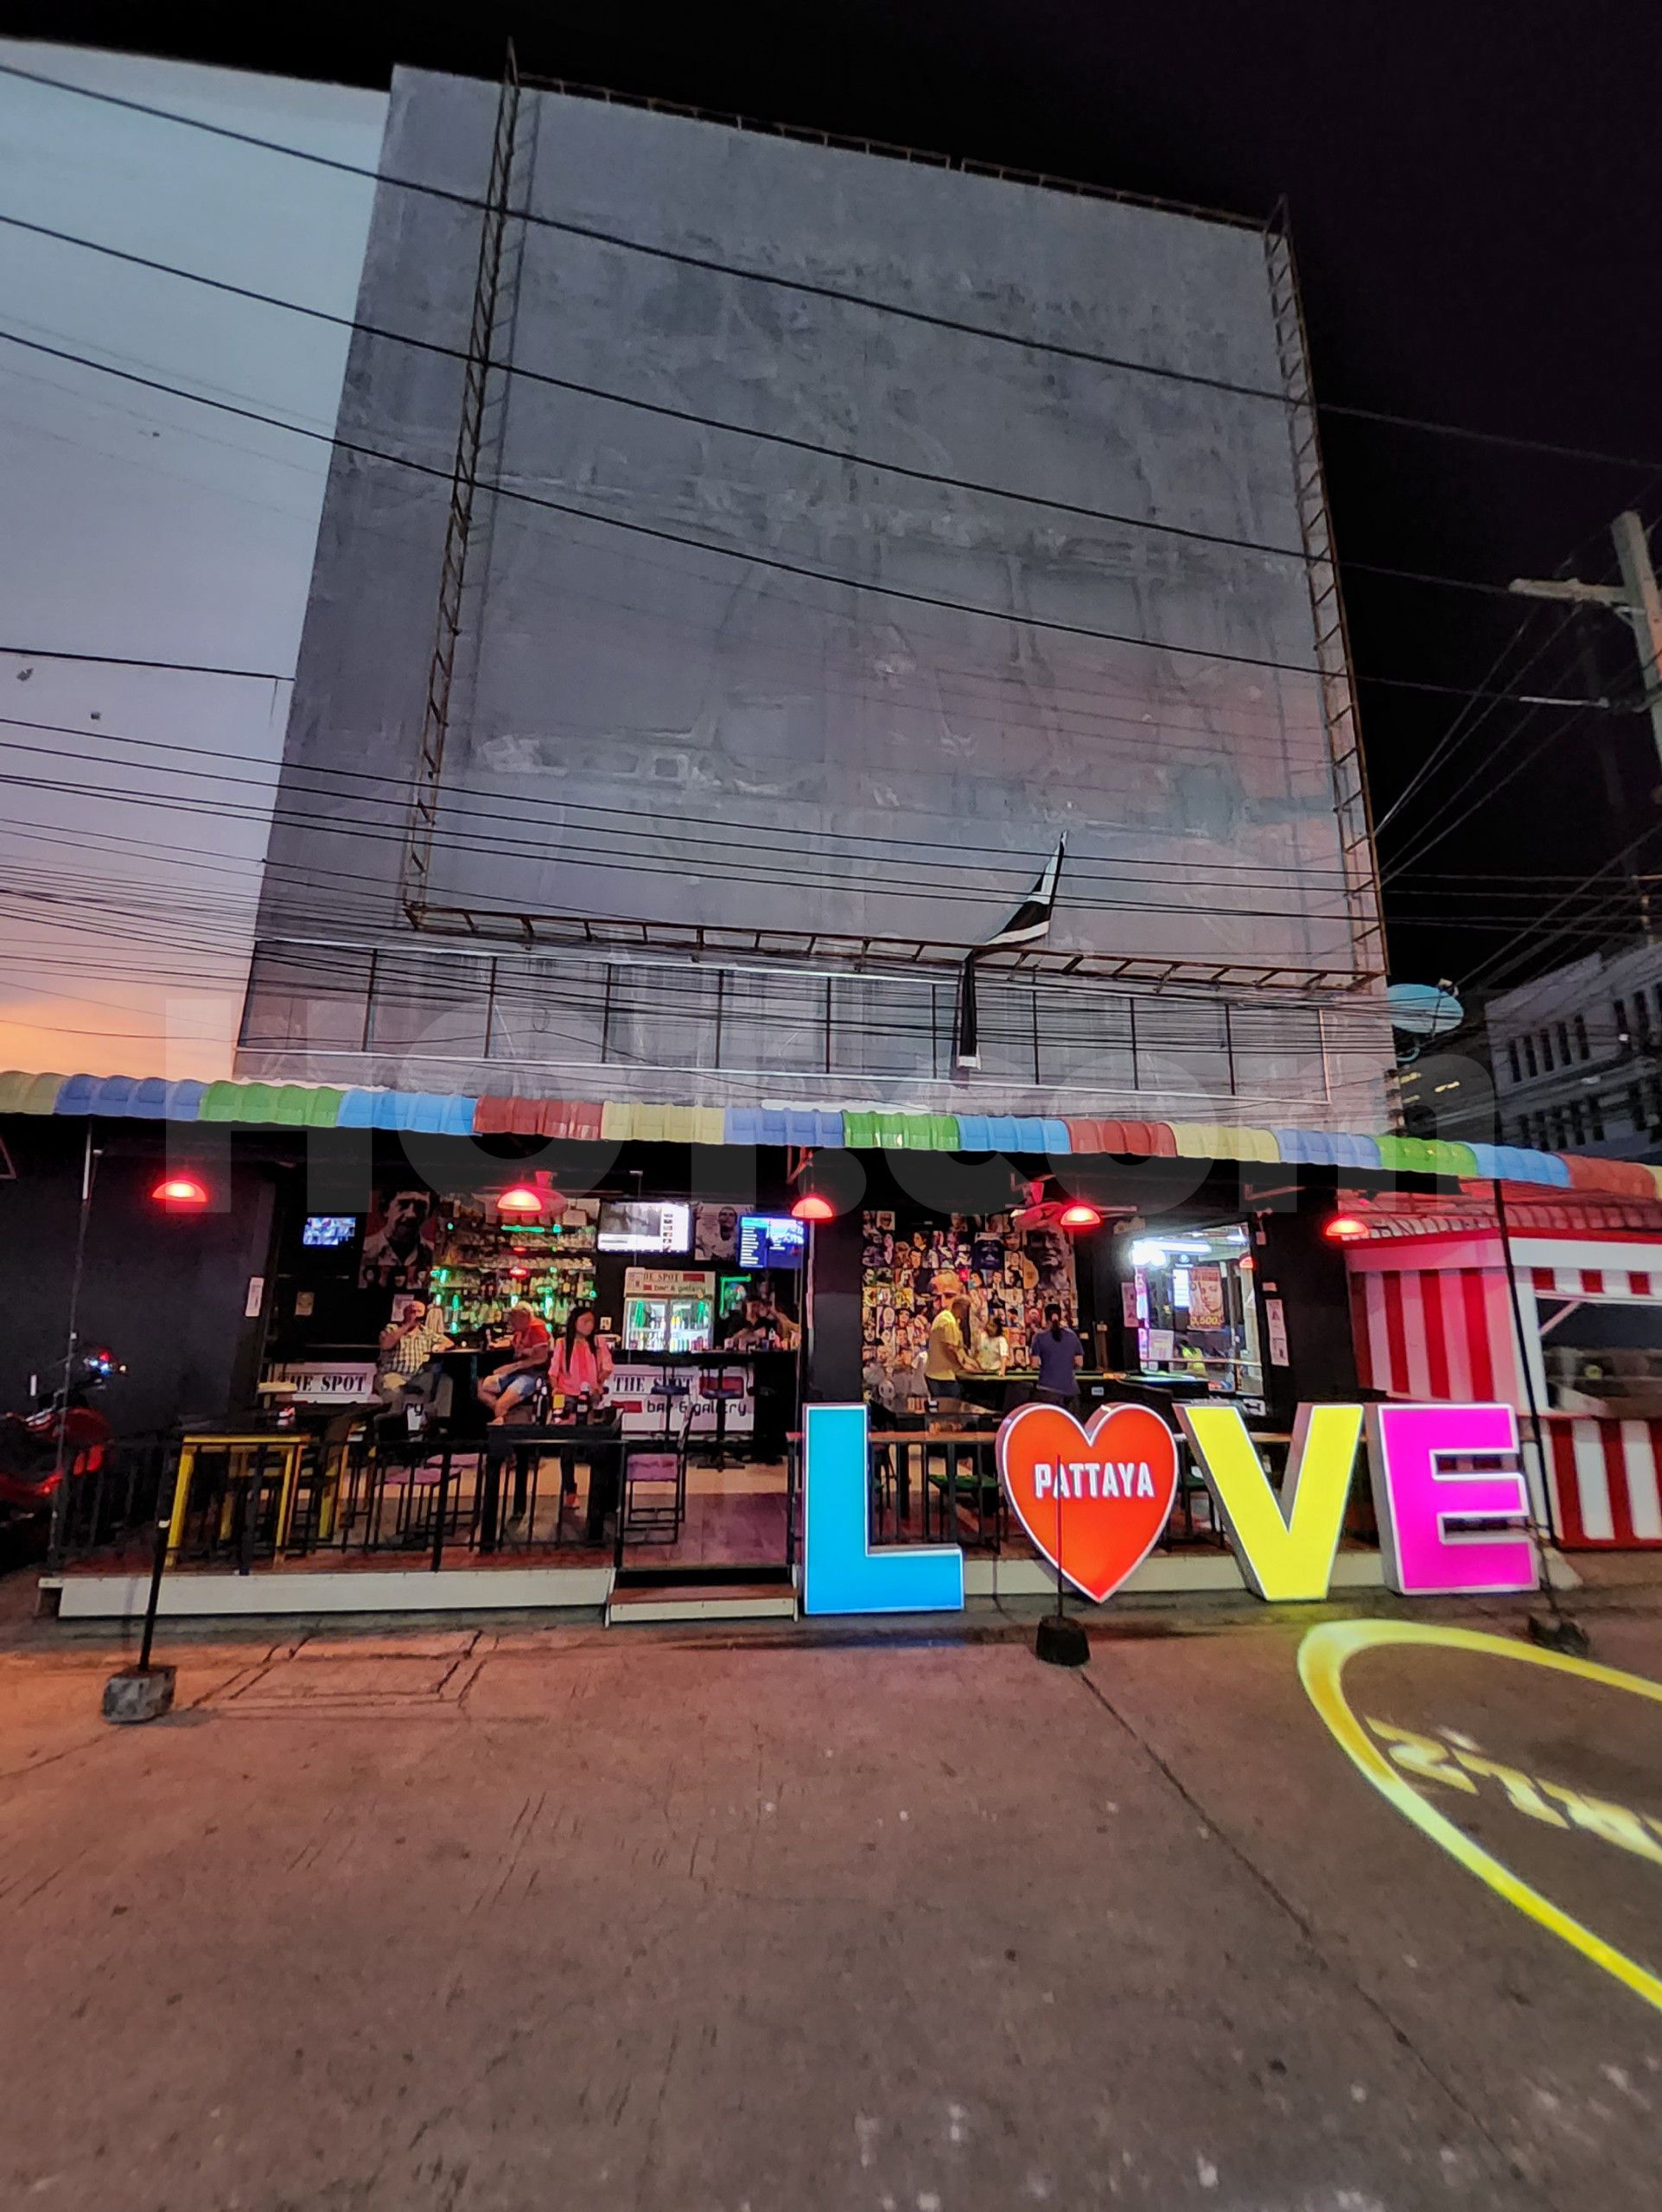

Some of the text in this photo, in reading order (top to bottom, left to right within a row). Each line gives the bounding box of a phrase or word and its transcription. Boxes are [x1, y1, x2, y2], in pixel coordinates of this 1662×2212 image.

[321, 1375, 366, 1392] SPOT
[614, 1376, 646, 1392] THE
[694, 1402, 747, 1417] galry
[1035, 1461, 1156, 1499] PATTAYA
